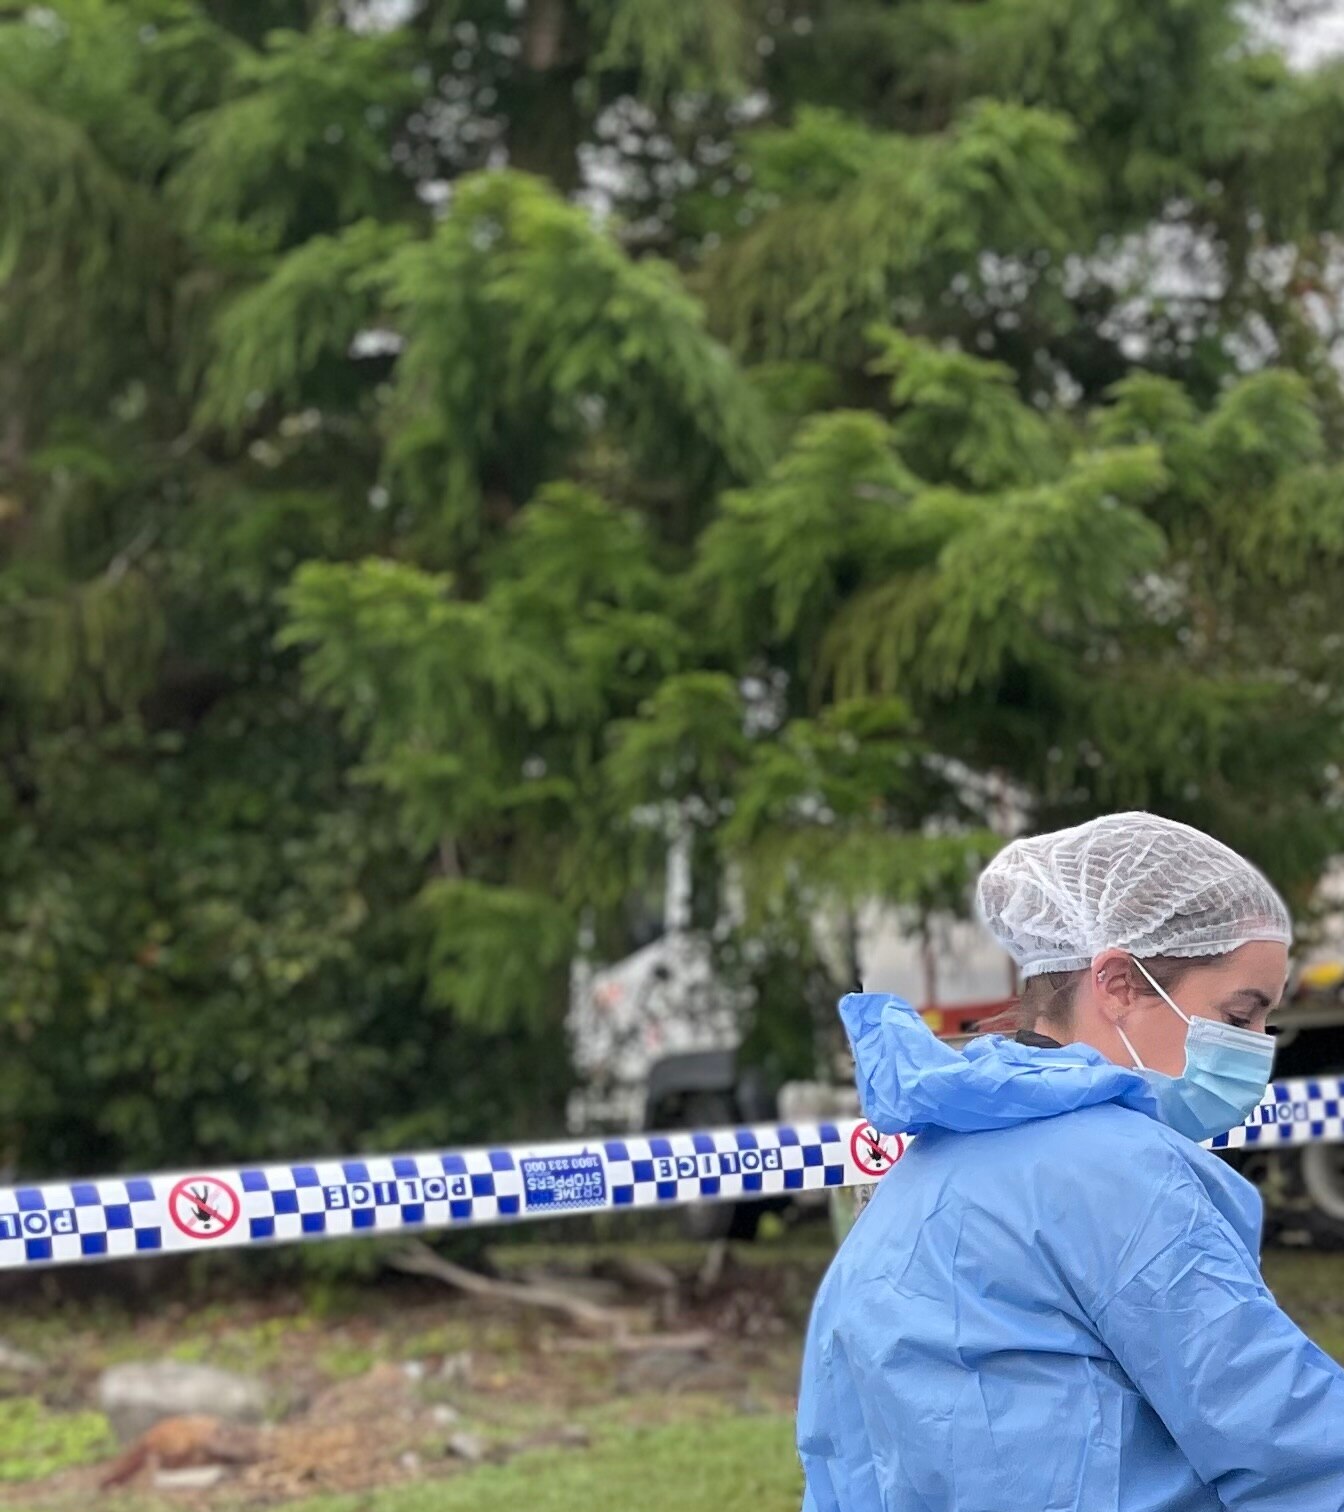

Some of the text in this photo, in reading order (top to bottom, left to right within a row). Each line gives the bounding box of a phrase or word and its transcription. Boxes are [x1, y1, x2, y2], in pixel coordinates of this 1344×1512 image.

[659, 1149, 779, 1177] POLICE
[329, 1177, 467, 1208] POLICE
[527, 1172, 601, 1190] STOPPERS
[553, 1185, 602, 1201] CRIME
